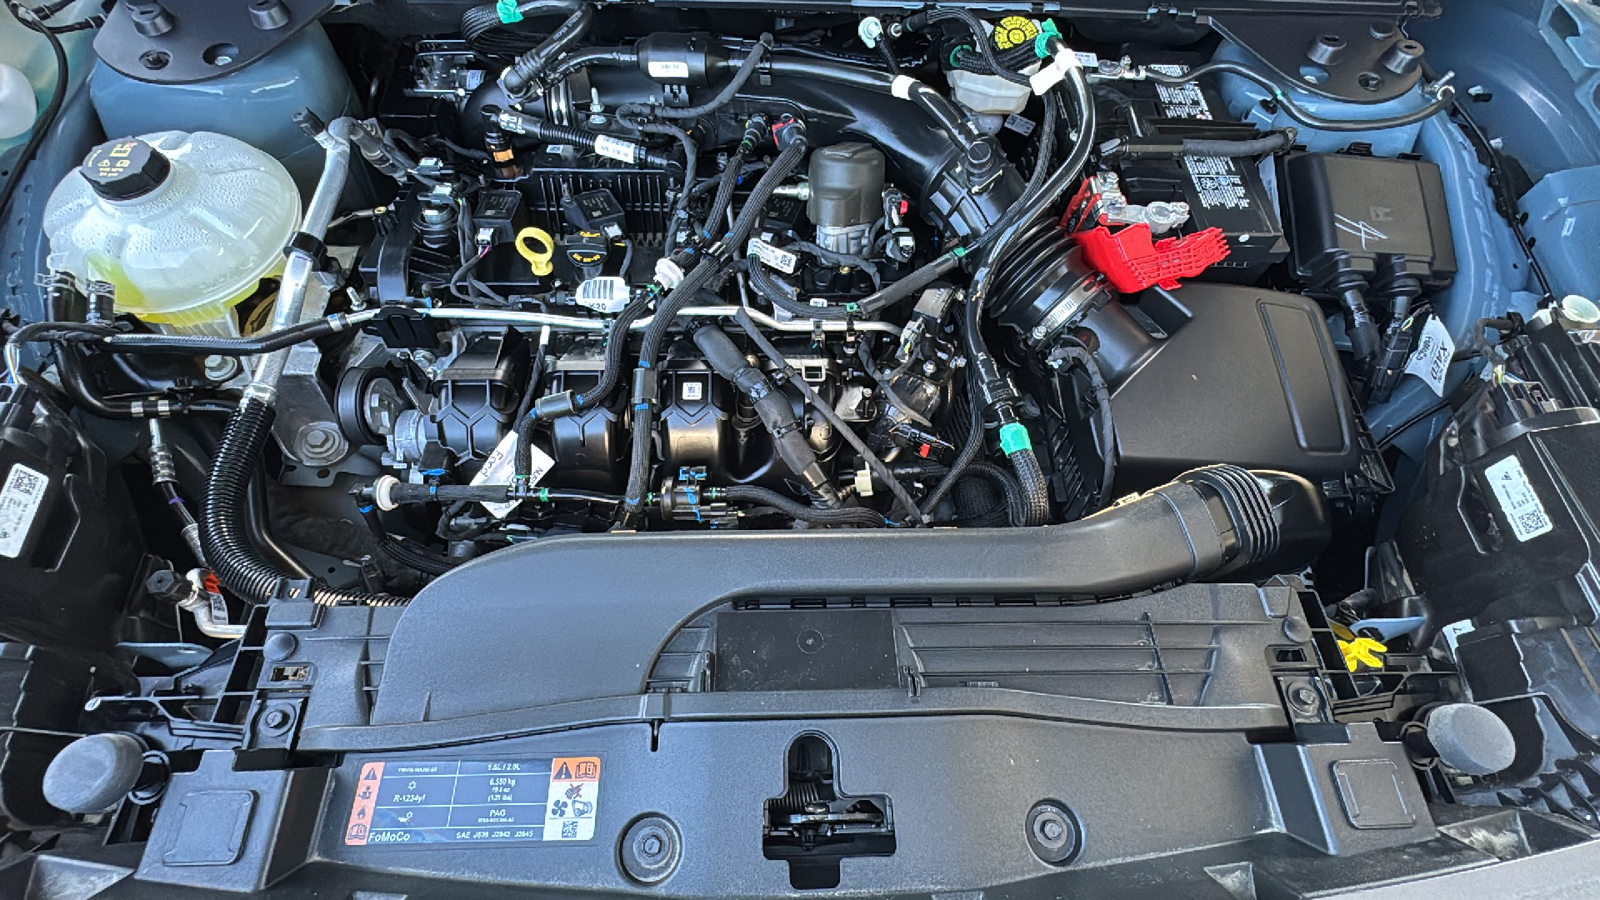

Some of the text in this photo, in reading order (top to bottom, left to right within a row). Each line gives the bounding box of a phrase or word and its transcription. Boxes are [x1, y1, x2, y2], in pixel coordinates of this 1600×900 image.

[489, 808, 507, 817] PAG
[367, 831, 411, 843] FoMoCo
[456, 831, 471, 839] SAE
